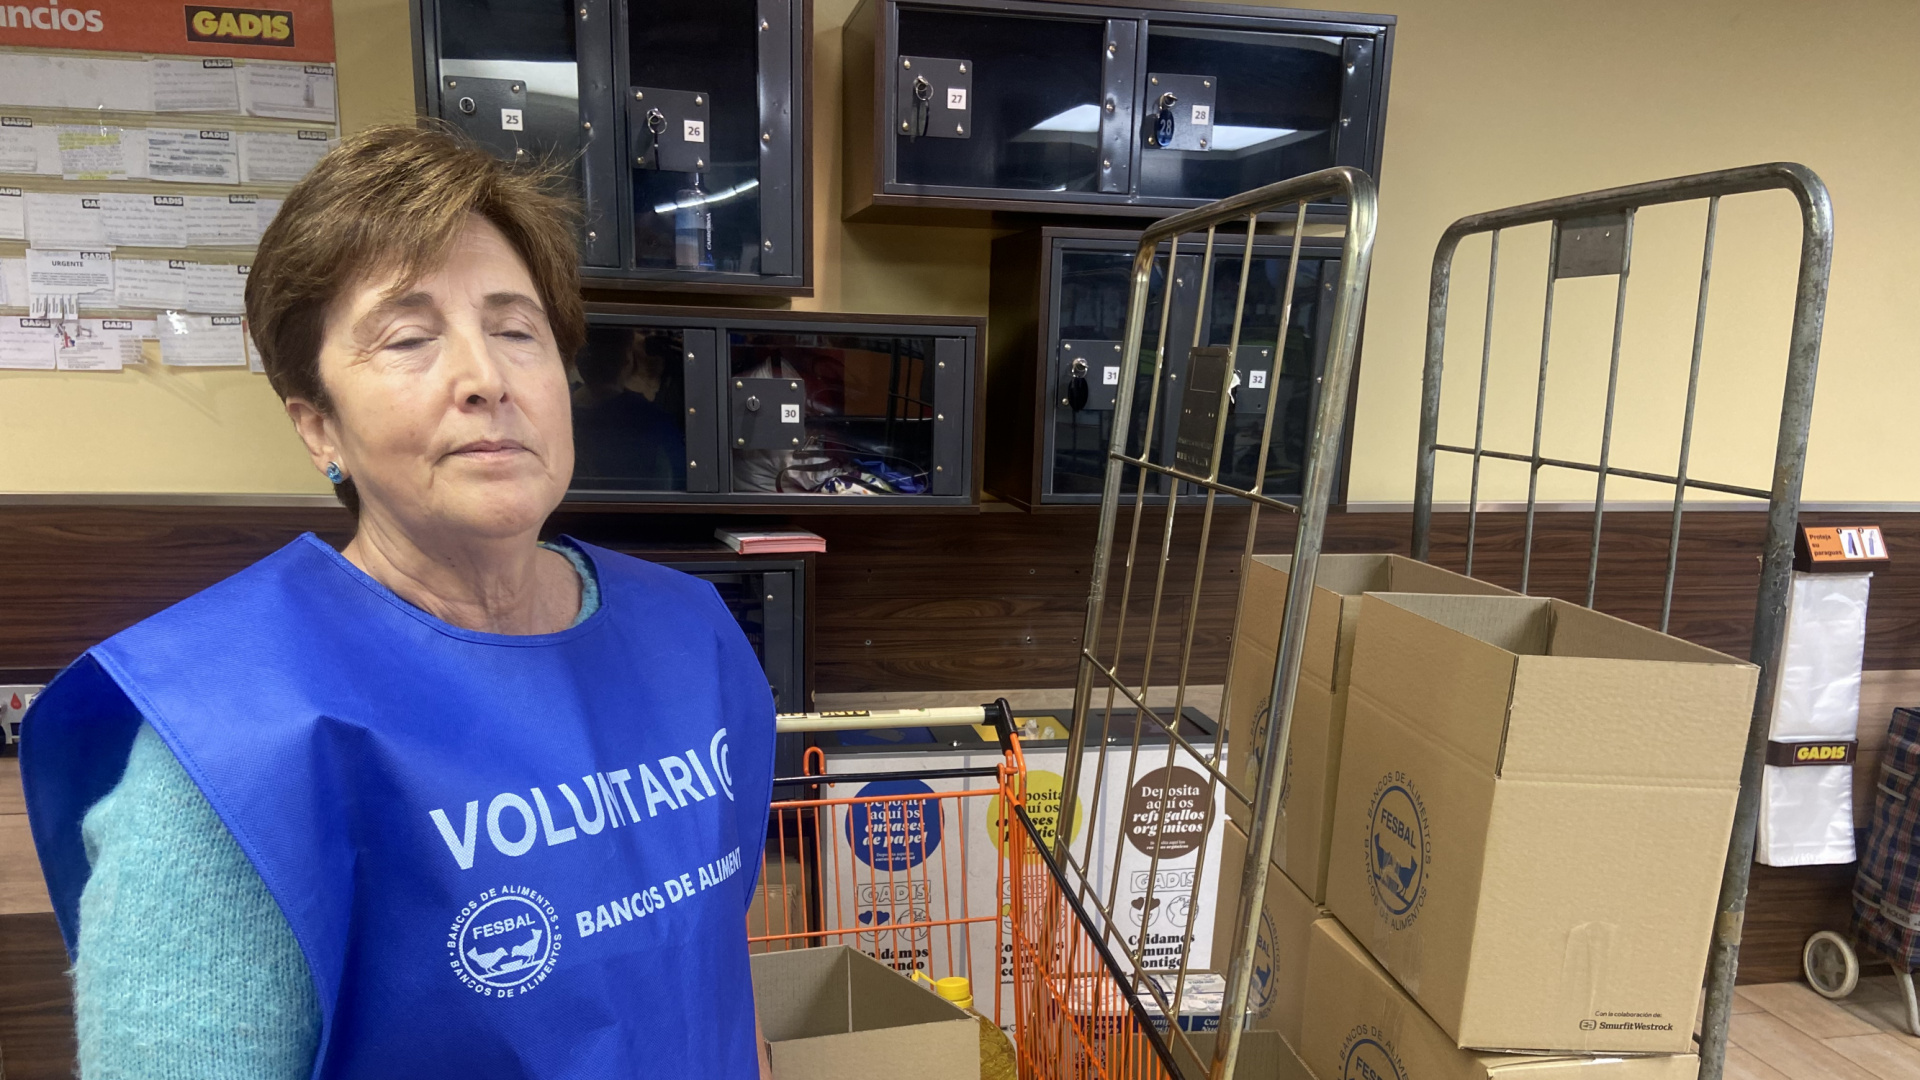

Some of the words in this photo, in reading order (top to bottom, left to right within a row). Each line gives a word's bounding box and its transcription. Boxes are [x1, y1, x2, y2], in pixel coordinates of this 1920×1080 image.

[192, 10, 290, 39] GADIS
[204, 60, 232, 68] GADIS
[306, 67, 333, 75] GADIS
[951, 94, 963, 104] 27
[505, 115, 519, 124] 25
[1195, 110, 1206, 120] 28
[3, 118, 31, 126] GADIS
[687, 126, 700, 136] 26
[1160, 119, 1172, 136] 28
[201, 131, 229, 140] GADIS
[299, 131, 327, 140] GADIS
[83, 199, 100, 208] GA
[155, 197, 183, 205] GADIS
[230, 194, 255, 203] GAD
[82, 252, 110, 260] GADIS
[51, 260, 84, 268] URGENTE
[21, 319, 50, 328] GADIS
[104, 321, 132, 329] GADIS
[213, 316, 241, 325] GADIS
[1106, 371, 1117, 380] 31
[1252, 375, 1263, 384] 32
[784, 409, 797, 418] 30
[1797, 746, 1846, 760] GADIS
[1179, 800, 1194, 808] os
[870, 806, 902, 822] aquí
[906, 809, 921, 818] os
[1367, 771, 1393, 819] BANCOS
[1395, 770, 1406, 784] DE
[1406, 779, 1432, 865] ALIMENTOS
[1133, 821, 1203, 836] orgnicos
[1380, 808, 1416, 849] FESBAL
[574, 886, 666, 938] BANCOS
[663, 873, 696, 904] DE
[1390, 886, 1427, 931] ALIMENTOS
[447, 900, 478, 949] BANCOS
[480, 888, 498, 902] DE
[501, 885, 559, 923] ALIMENTOS
[472, 912, 536, 940] FESBAL
[1128, 933, 1195, 946] Cidamos
[1142, 944, 1190, 956] mund
[450, 960, 493, 996] BANCOS
[497, 988, 515, 998] DE
[520, 934, 562, 994] ALIMENTOS
[1141, 956, 1182, 970] ontig
[1340, 1024, 1368, 1060] BANCOS
[1371, 1026, 1382, 1041] DE
[1356, 1056, 1383, 1080] FES
